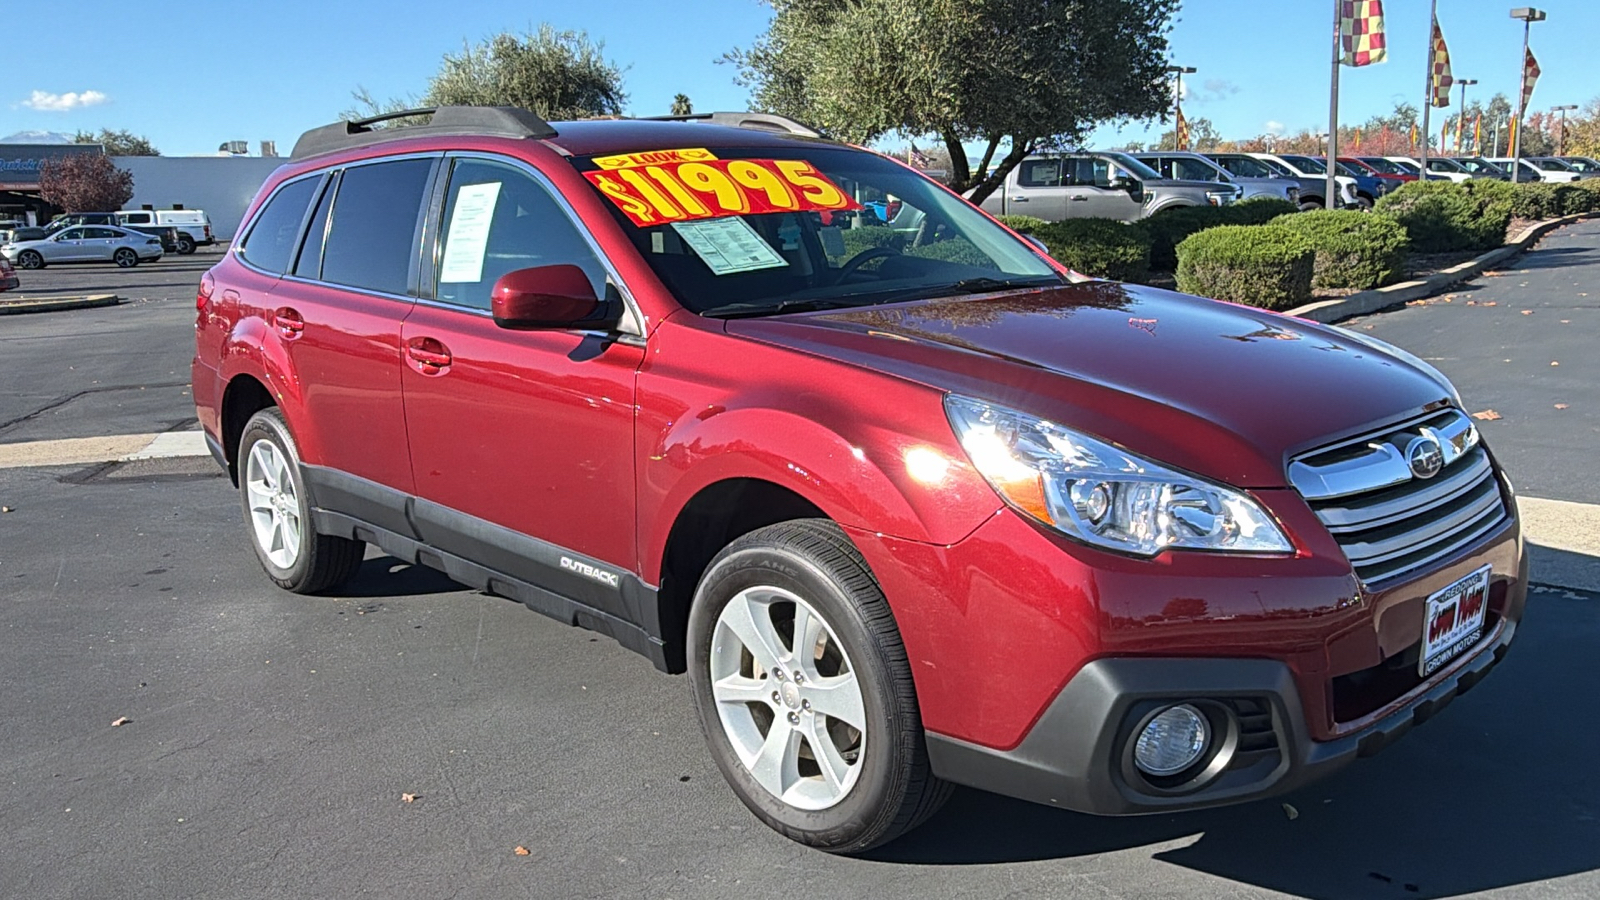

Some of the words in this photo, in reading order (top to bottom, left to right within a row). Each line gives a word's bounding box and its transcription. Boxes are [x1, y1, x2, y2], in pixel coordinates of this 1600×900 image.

[628, 151, 688, 164] LOOK
[594, 160, 848, 222] $11995
[560, 556, 618, 587] OUTBACK
[1444, 575, 1480, 600] REDDING
[1427, 647, 1453, 672] CROWN
[1452, 630, 1481, 653] MOTORS
